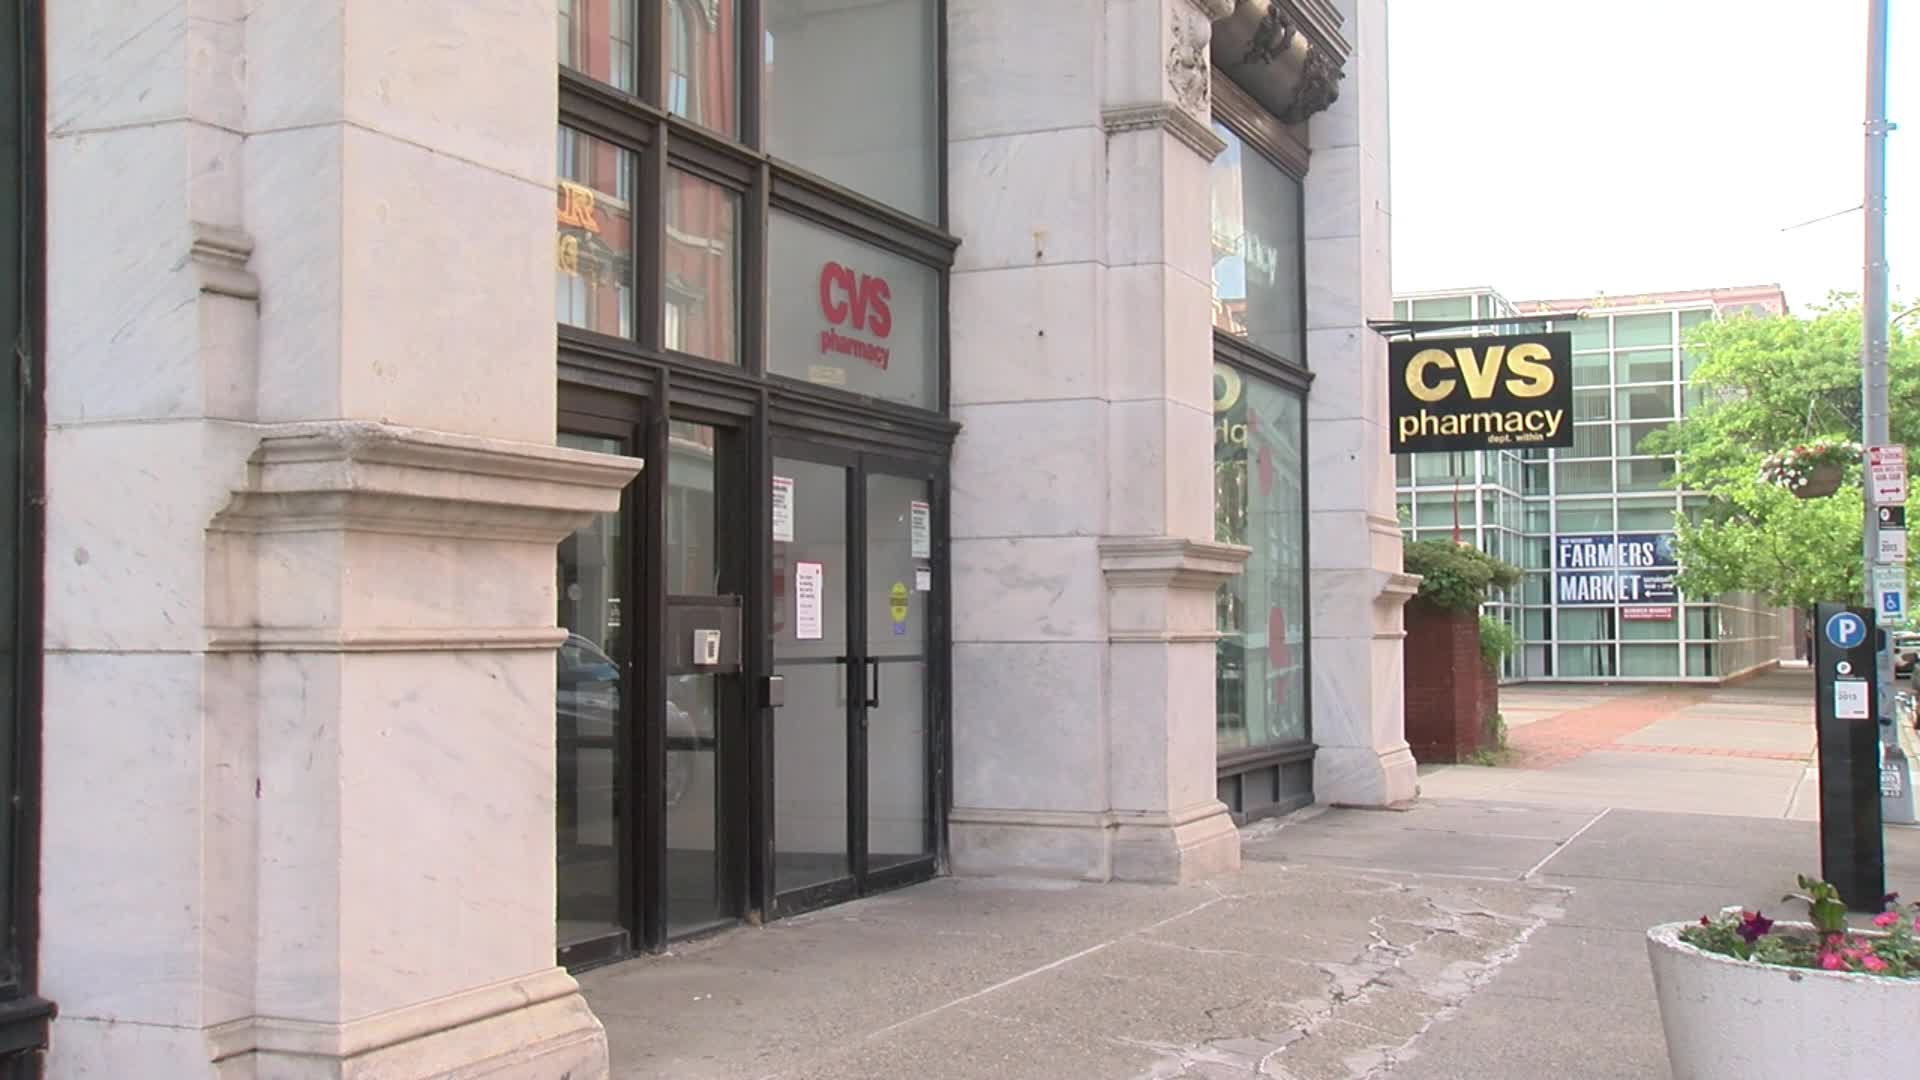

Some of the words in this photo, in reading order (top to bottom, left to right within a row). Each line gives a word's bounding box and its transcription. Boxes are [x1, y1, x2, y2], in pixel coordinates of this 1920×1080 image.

[819, 261, 892, 338] CVS
[820, 328, 889, 371] pharmacy
[1405, 343, 1555, 402] CVS
[1399, 409, 1564, 443] pharmacy
[1487, 433, 1513, 444] dept.
[1515, 432, 1545, 443] within
[1560, 541, 1655, 568] FARMERS
[1561, 574, 1642, 601] MARKET
[1839, 618, 1857, 643] P
